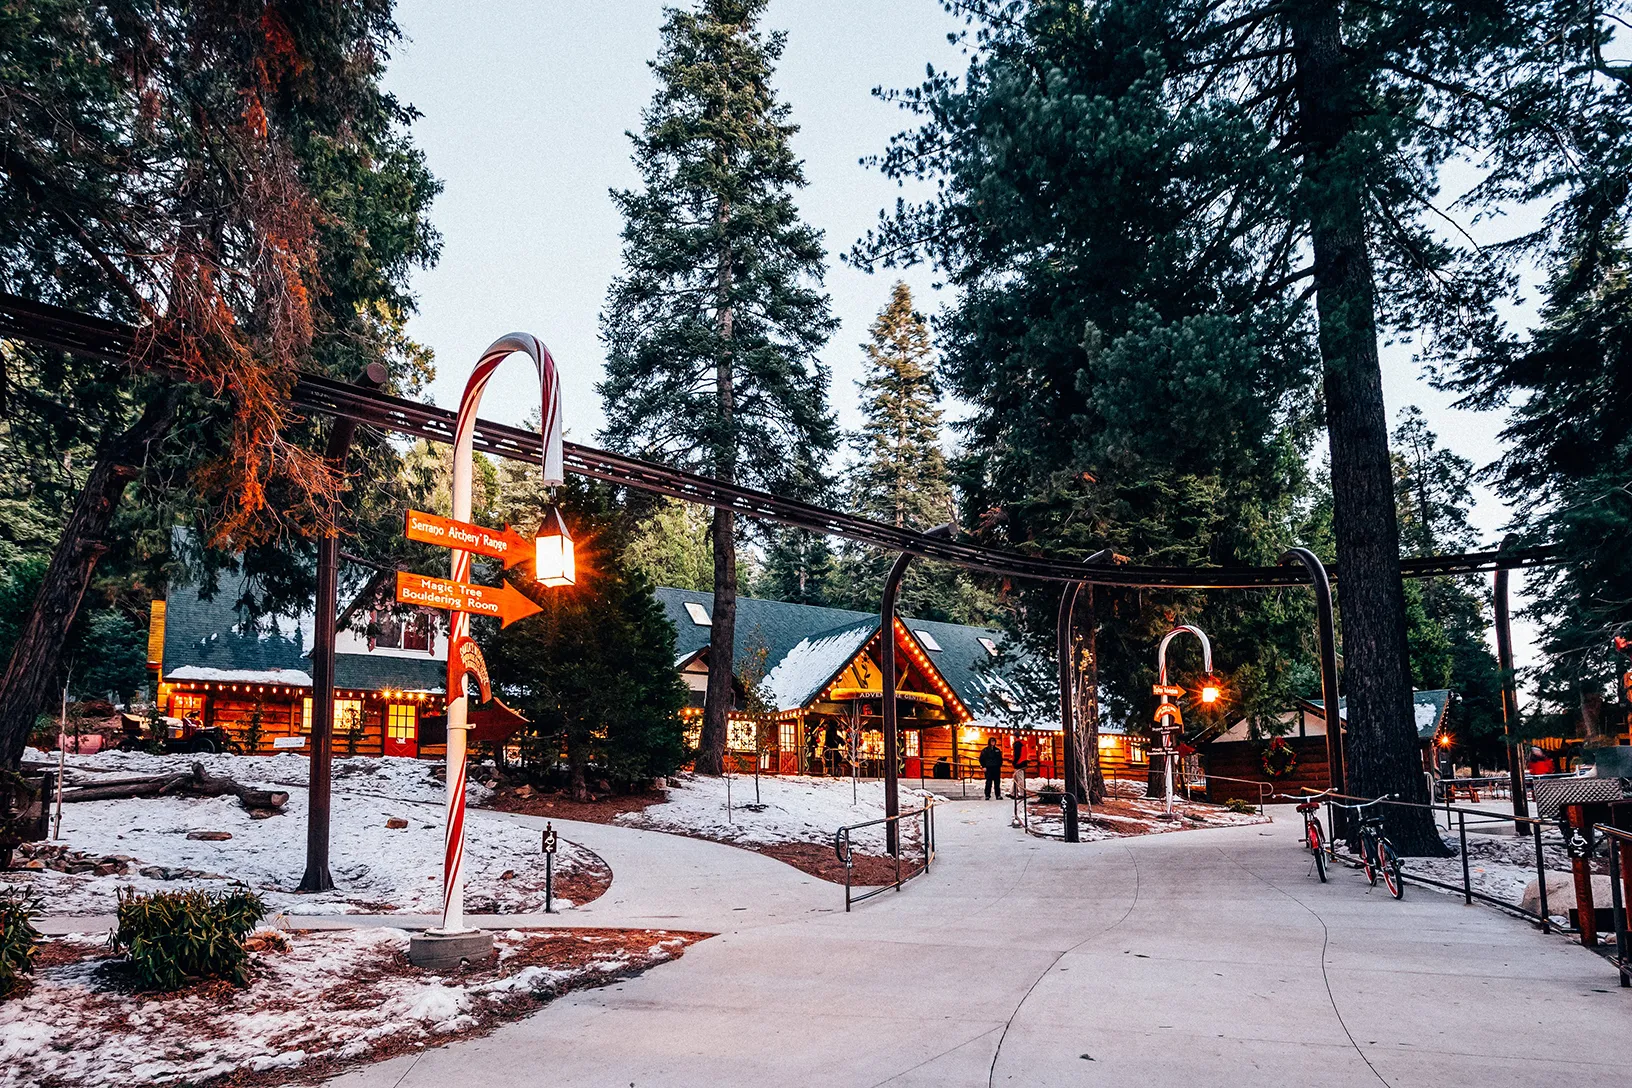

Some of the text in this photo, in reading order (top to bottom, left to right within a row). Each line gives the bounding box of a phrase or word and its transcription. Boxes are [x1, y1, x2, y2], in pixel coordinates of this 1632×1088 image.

[412, 518, 507, 552] Serrano Archery Range
[402, 588, 498, 612] Bouldering Room
[421, 579, 482, 597] Magic Tree
